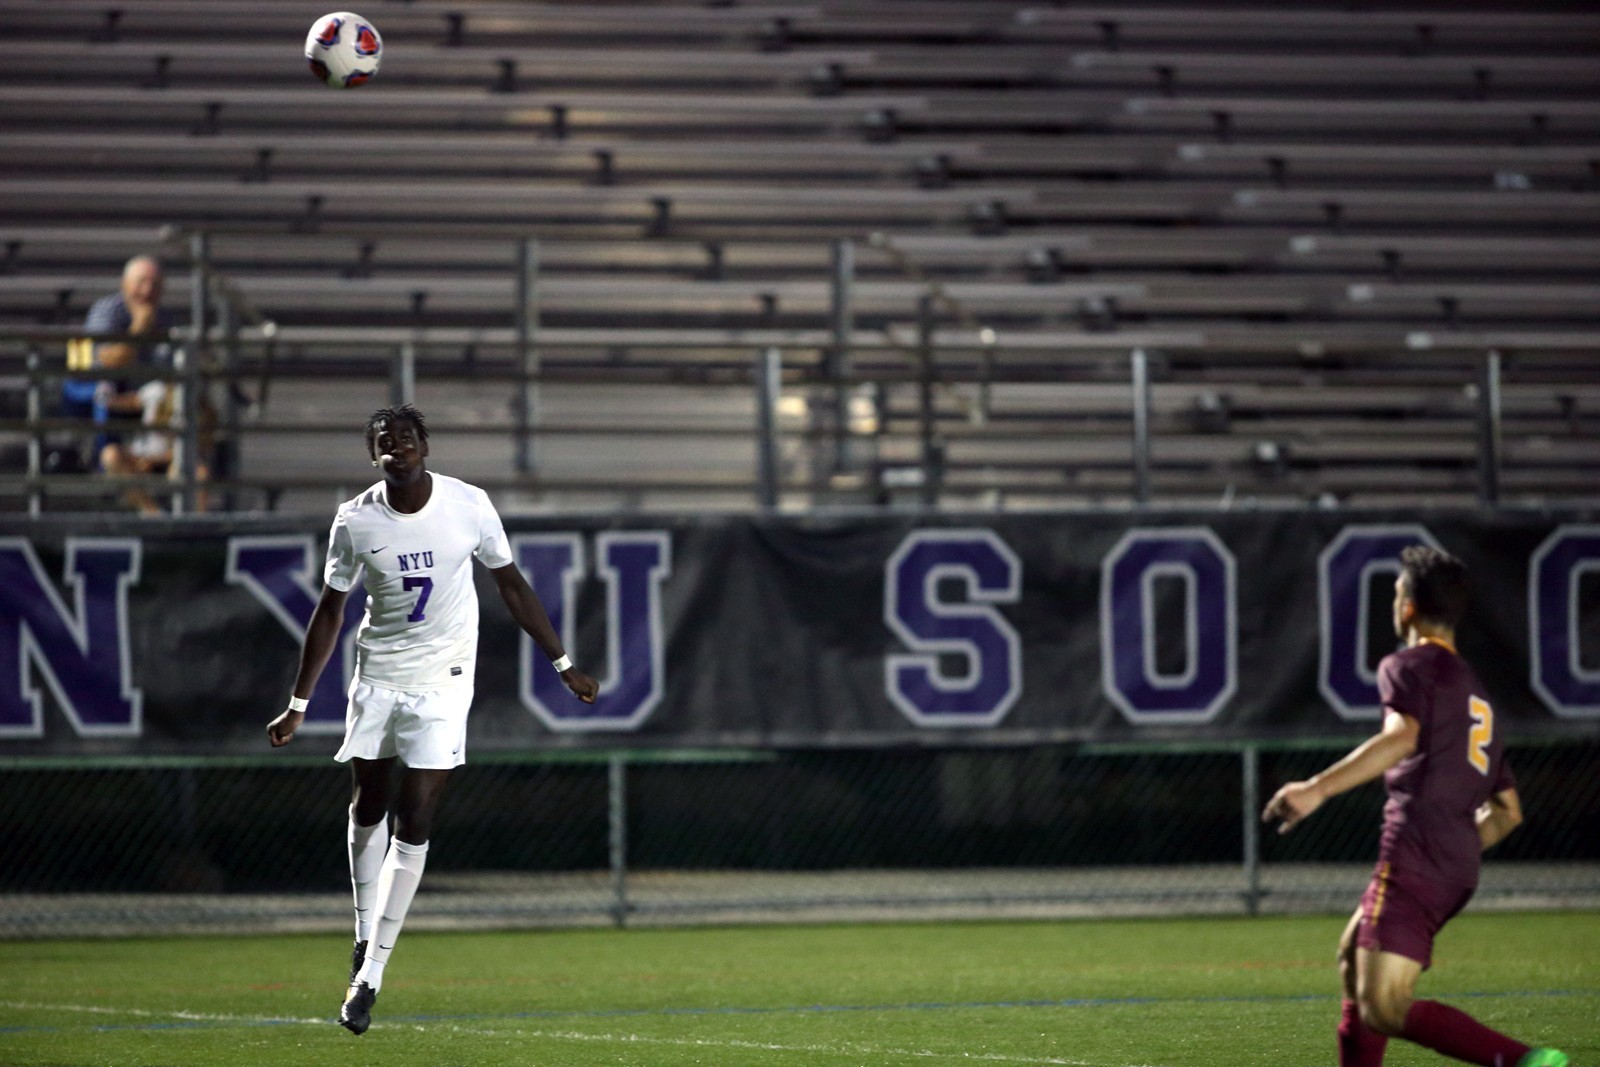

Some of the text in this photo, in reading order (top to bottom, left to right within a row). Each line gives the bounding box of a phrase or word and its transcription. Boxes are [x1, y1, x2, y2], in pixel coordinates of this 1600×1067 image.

[397, 551, 434, 571] NYU
[403, 576, 434, 622] 7
[1467, 694, 1494, 776] 2
